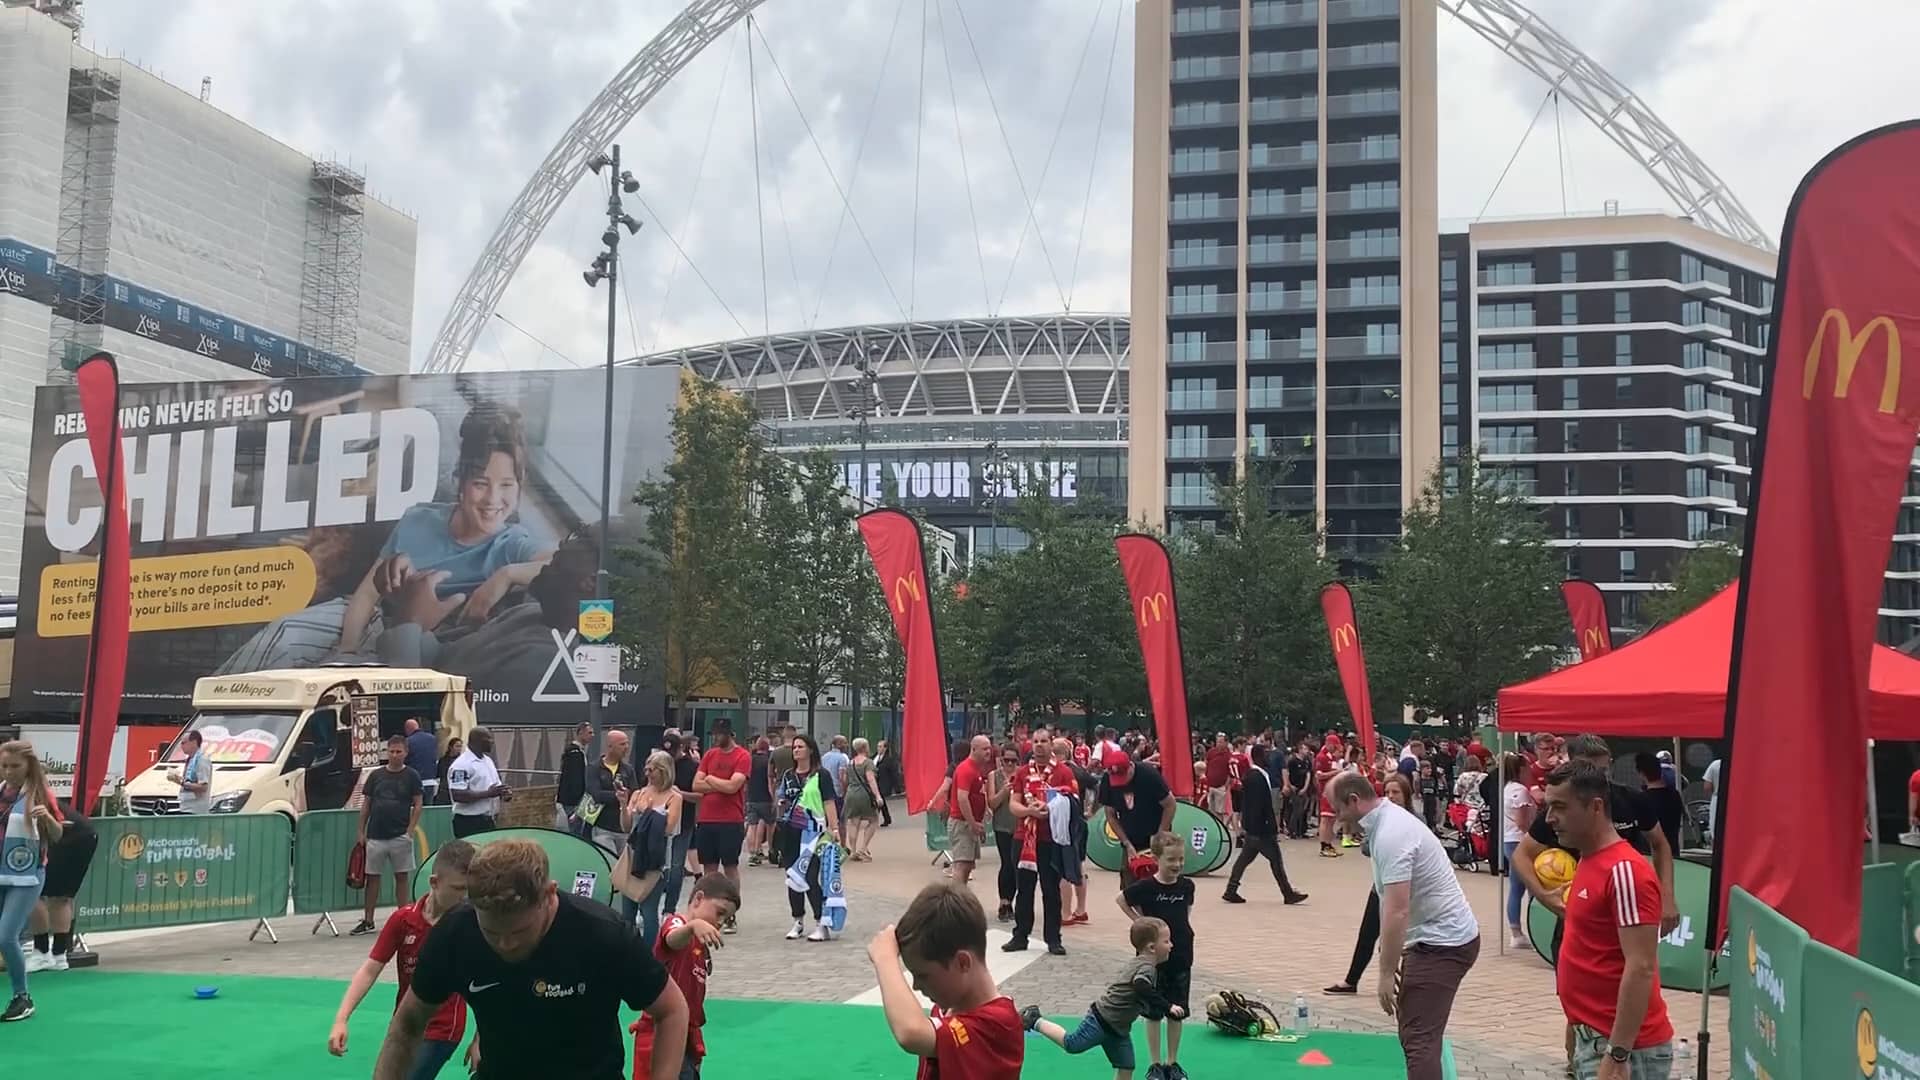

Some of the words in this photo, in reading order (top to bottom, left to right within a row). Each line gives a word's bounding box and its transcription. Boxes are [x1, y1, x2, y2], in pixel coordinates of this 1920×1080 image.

[54, 406, 150, 435] REBING
[156, 400, 216, 425] NEVER
[221, 394, 263, 418] FELT
[267, 389, 293, 414] SO
[45, 408, 440, 553] CHILLED
[835, 461, 882, 498] ARE
[891, 461, 971, 498] YOUR
[52, 576, 96, 589] Renting
[142, 572, 152, 583] is
[155, 572, 177, 584] way
[179, 568, 209, 580] more
[212, 565, 231, 577] fun
[233, 563, 260, 577] (and
[263, 560, 295, 573] much
[51, 594, 74, 606] less
[137, 587, 177, 600] there's
[180, 585, 195, 597] no
[198, 581, 243, 596] deposit
[246, 580, 259, 591] to
[262, 578, 286, 592] pay,
[49, 612, 64, 621] no
[67, 609, 91, 621] fees
[135, 606, 161, 618] your
[164, 601, 189, 614] bills
[191, 599, 210, 612] are
[230, 682, 276, 697] Whippy
[472, 688, 509, 702] ellion
[602, 681, 639, 694] embley
[146, 847, 172, 864] FUN
[176, 843, 236, 861] FOOTBALL
[79, 903, 120, 917] Search
